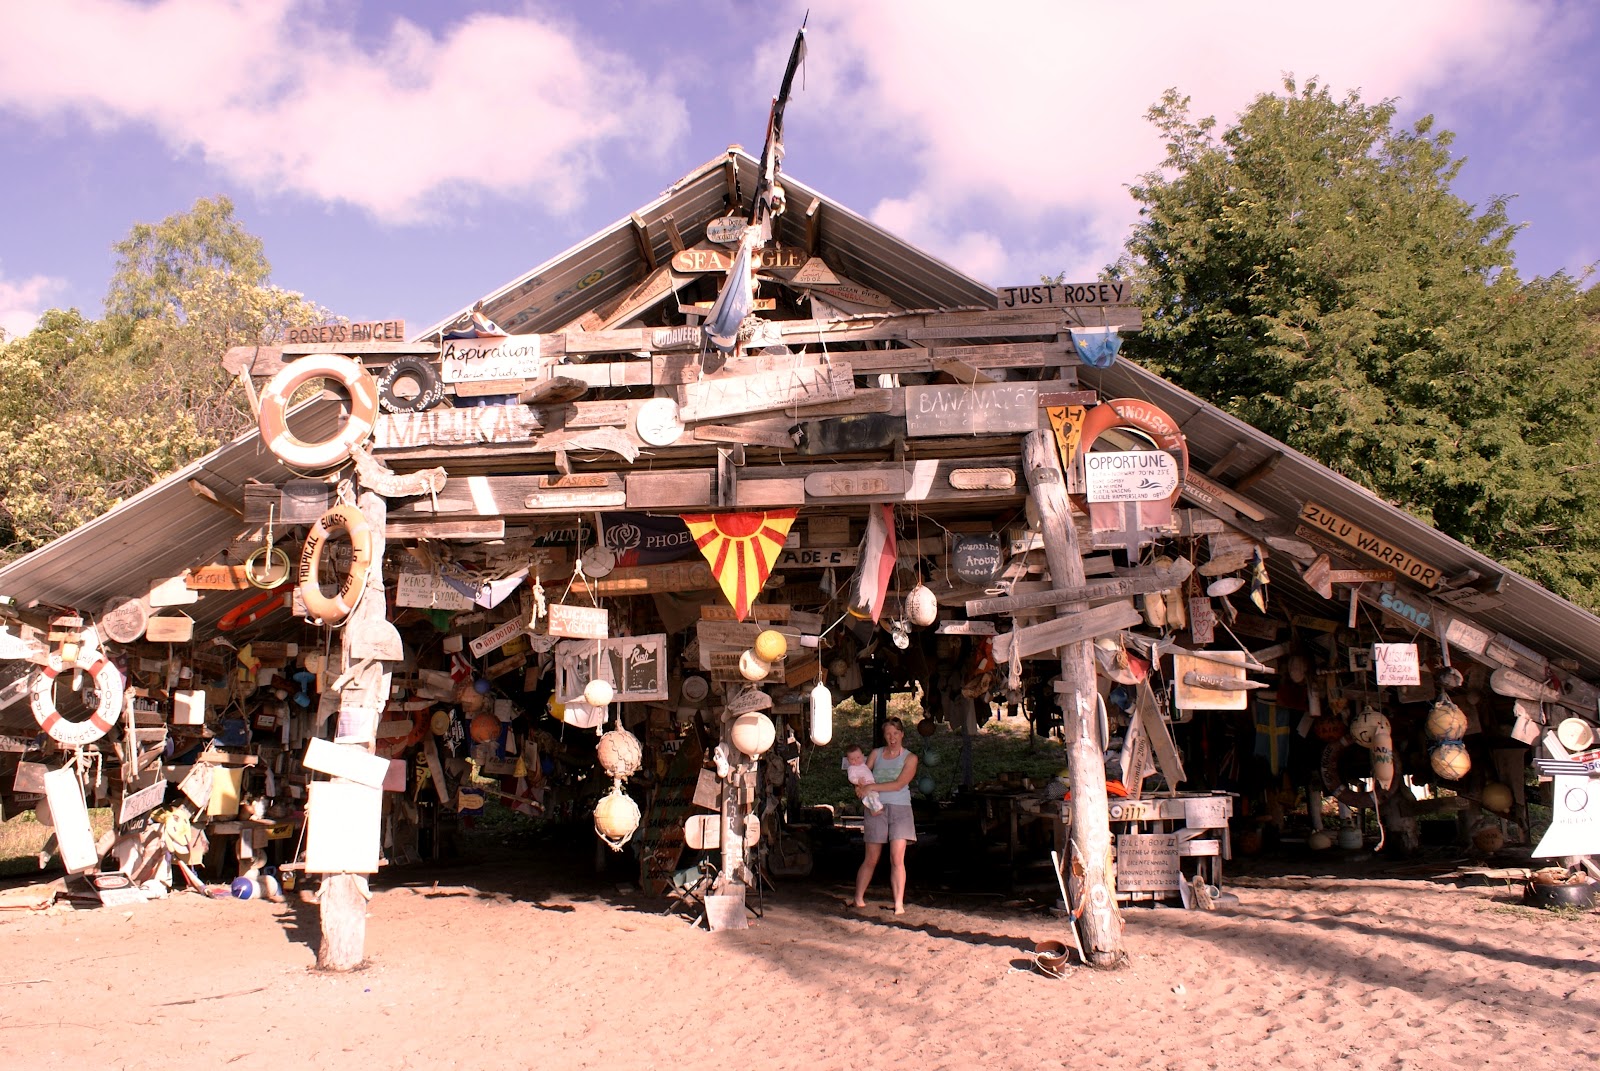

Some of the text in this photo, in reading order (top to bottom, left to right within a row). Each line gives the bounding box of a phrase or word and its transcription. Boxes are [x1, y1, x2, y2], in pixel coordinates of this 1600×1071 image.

[678, 251, 724, 269] SEA
[1004, 284, 1124, 308] JUST ROSEY
[289, 321, 404, 344] ROSEY'S ANGEL
[443, 342, 534, 366] Aspiration
[1089, 454, 1168, 470] OPPORTUNE
[321, 513, 348, 530] SUNSET
[543, 527, 591, 542] WIND
[1306, 506, 1437, 585] ZULU WARRIOR
[1337, 571, 1394, 581] SUPERTRAMP
[1130, 738, 1147, 799] Absconder 2006
[1121, 838, 1145, 847] BILLY
[1148, 838, 1165, 847] BOY
